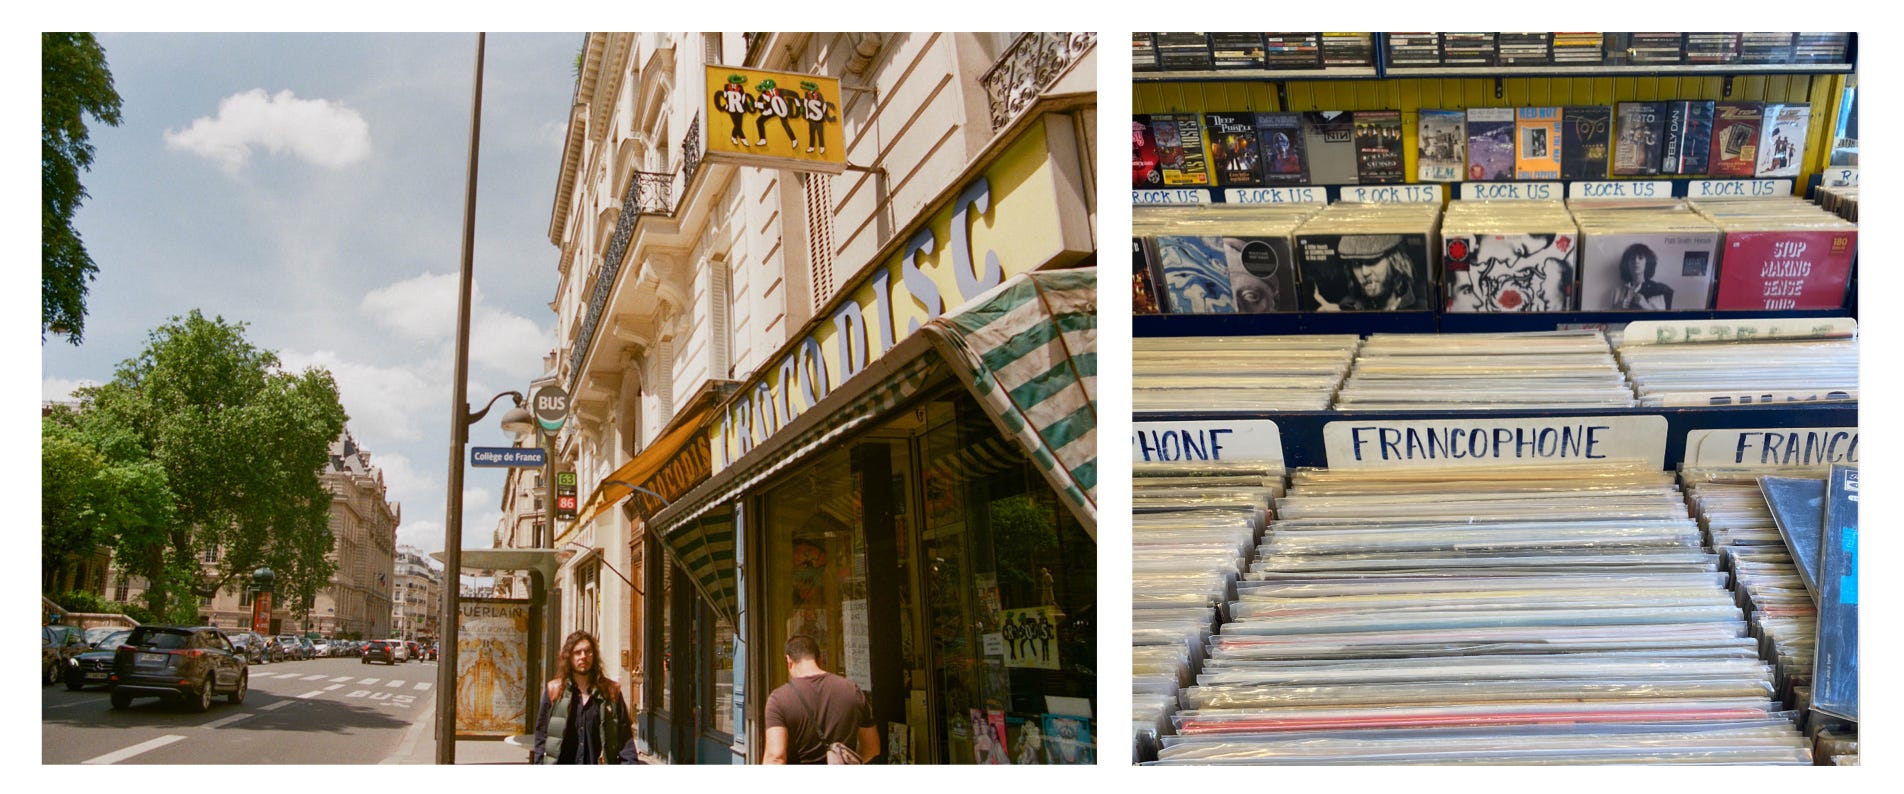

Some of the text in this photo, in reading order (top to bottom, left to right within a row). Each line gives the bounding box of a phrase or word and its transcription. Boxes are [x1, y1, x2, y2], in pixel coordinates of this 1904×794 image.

[1355, 186, 1434, 203] ROCK US
[1474, 184, 1550, 199] ROCK US
[1584, 182, 1655, 197] ROCK US
[1701, 180, 1775, 196] ROCK US
[1132, 190, 1200, 204] ROCK US
[1237, 189, 1313, 203] ROCK US
[1774, 241, 1807, 258] STOP
[1760, 260, 1811, 277] MAKING
[1763, 280, 1804, 296] SENSE
[720, 176, 1000, 470] CROCODISC
[538, 396, 566, 410] BUS
[1132, 429, 1233, 461] HONE
[1352, 425, 1610, 460] FRANCOPHONE
[474, 452, 541, 463] Collège de France
[642, 428, 711, 512] CROCODIS
[560, 474, 575, 485] 63
[560, 497, 575, 509] 86
[459, 606, 522, 618] UERLAIN
